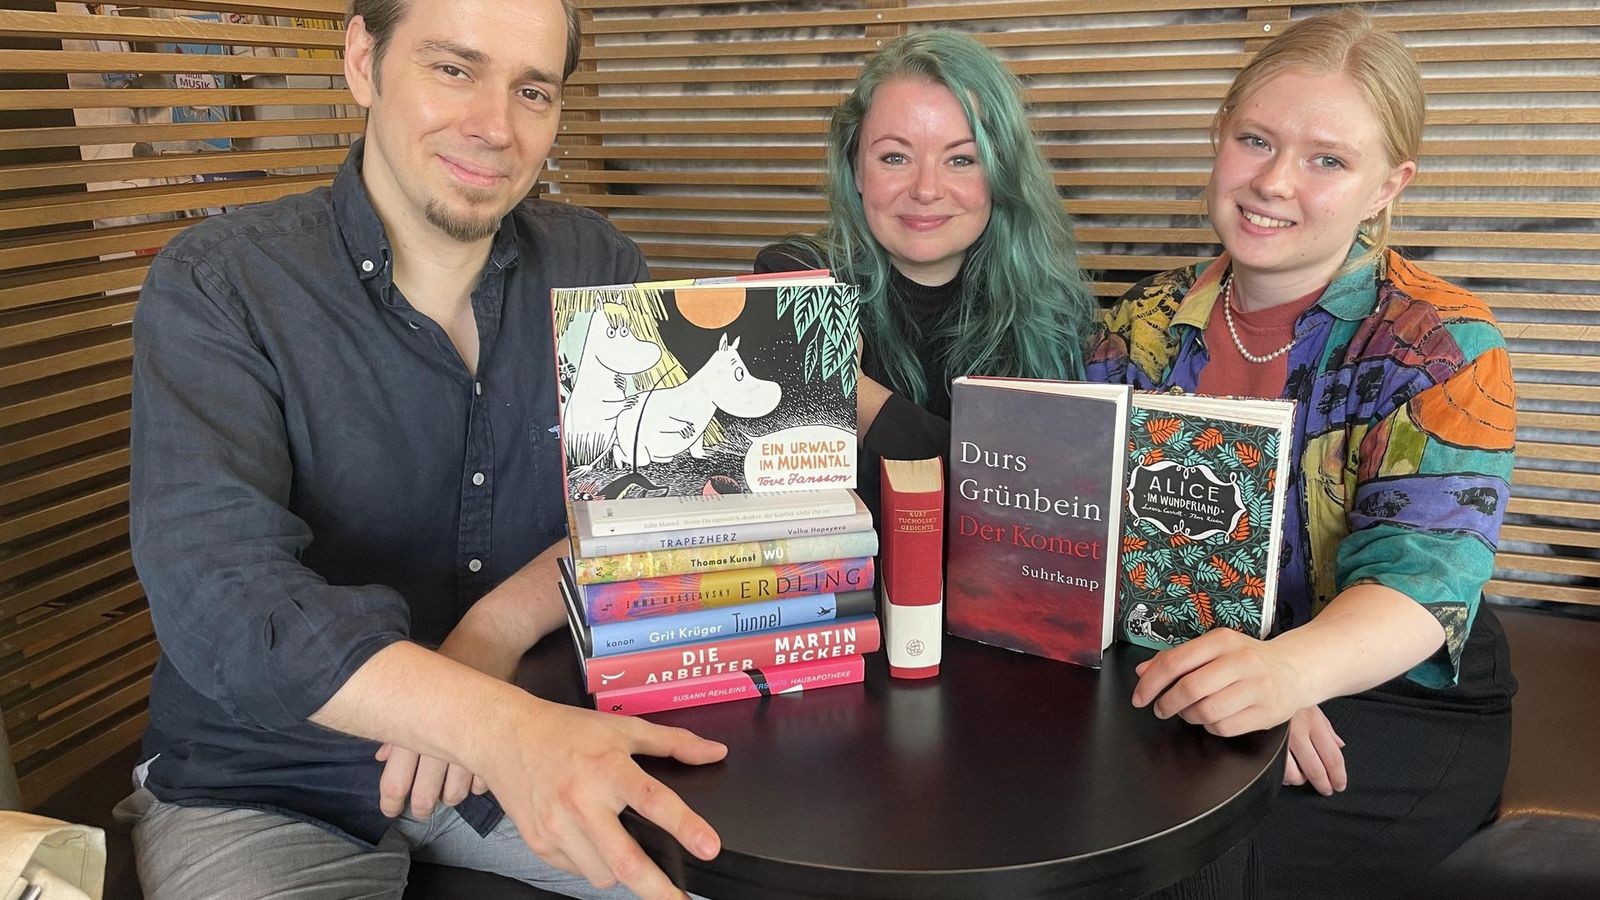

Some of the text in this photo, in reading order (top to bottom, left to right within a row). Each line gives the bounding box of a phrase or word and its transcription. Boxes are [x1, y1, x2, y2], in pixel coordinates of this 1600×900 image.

[180, 77, 210, 89] MUSIK
[762, 440, 846, 456] EIN URWALD
[960, 441, 1027, 473] Durs
[760, 455, 850, 470] IM MUMINTAL
[757, 473, 852, 486] Tove Jansson
[1149, 475, 1220, 502] ALICE
[959, 478, 1102, 522] Grünbein
[1147, 492, 1220, 516] IM WUNDERLAND
[660, 525, 847, 548] TRAPEZHERZ Volha Hapeyeva
[959, 515, 1101, 560] Der Komet
[691, 557, 728, 567] Thomas
[730, 553, 757, 564] Kunst
[626, 597, 656, 609] EMMA
[663, 589, 731, 605] BRASLAVSKY
[741, 568, 860, 598] ERDLING
[1021, 564, 1100, 591] Suhrkamp
[606, 606, 782, 648] kanon Grit Krüger Tunnel
[682, 627, 857, 666] DIE MARTIN
[645, 644, 856, 685] ARBEITER BECKER
[672, 691, 706, 703] SUSANN
[708, 685, 747, 697] REHLEINS
[790, 670, 851, 684] HAUSAPOTHEKE
